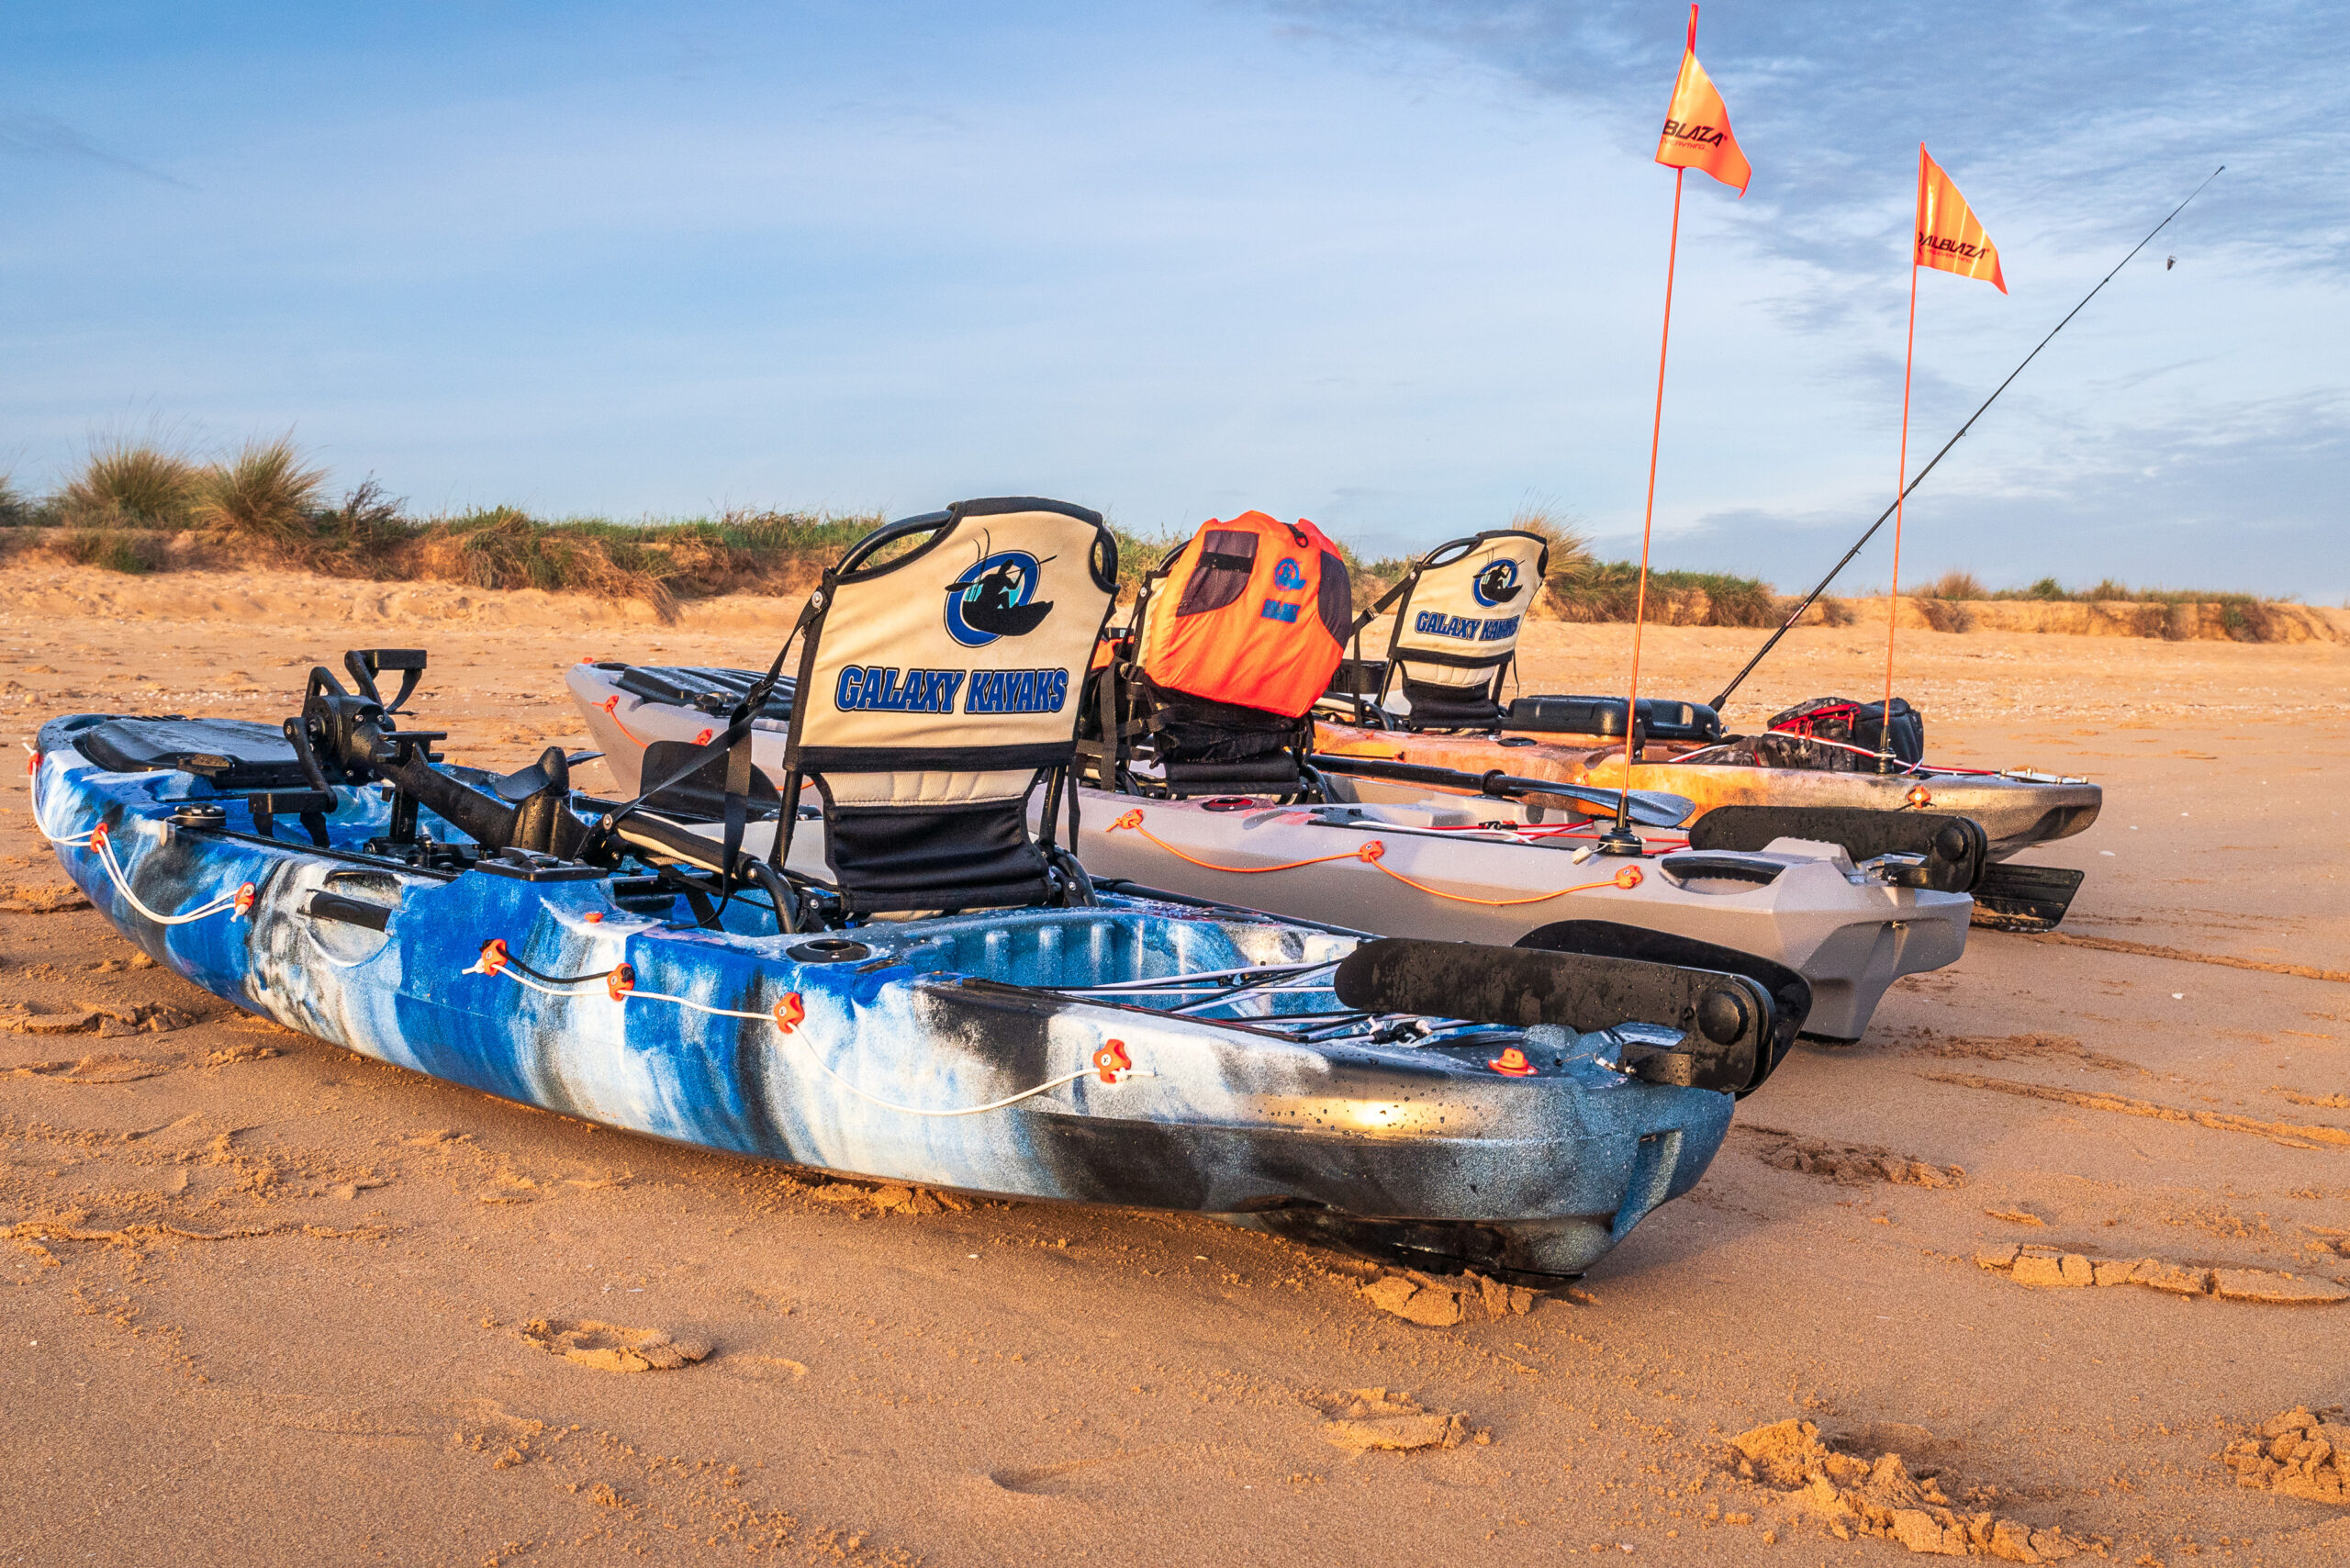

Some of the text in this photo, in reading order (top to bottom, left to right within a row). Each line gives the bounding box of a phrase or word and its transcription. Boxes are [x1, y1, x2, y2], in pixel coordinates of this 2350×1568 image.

[1415, 610, 1483, 641] GALAXY
[834, 665, 1069, 714] GALAXY KAYAKS
